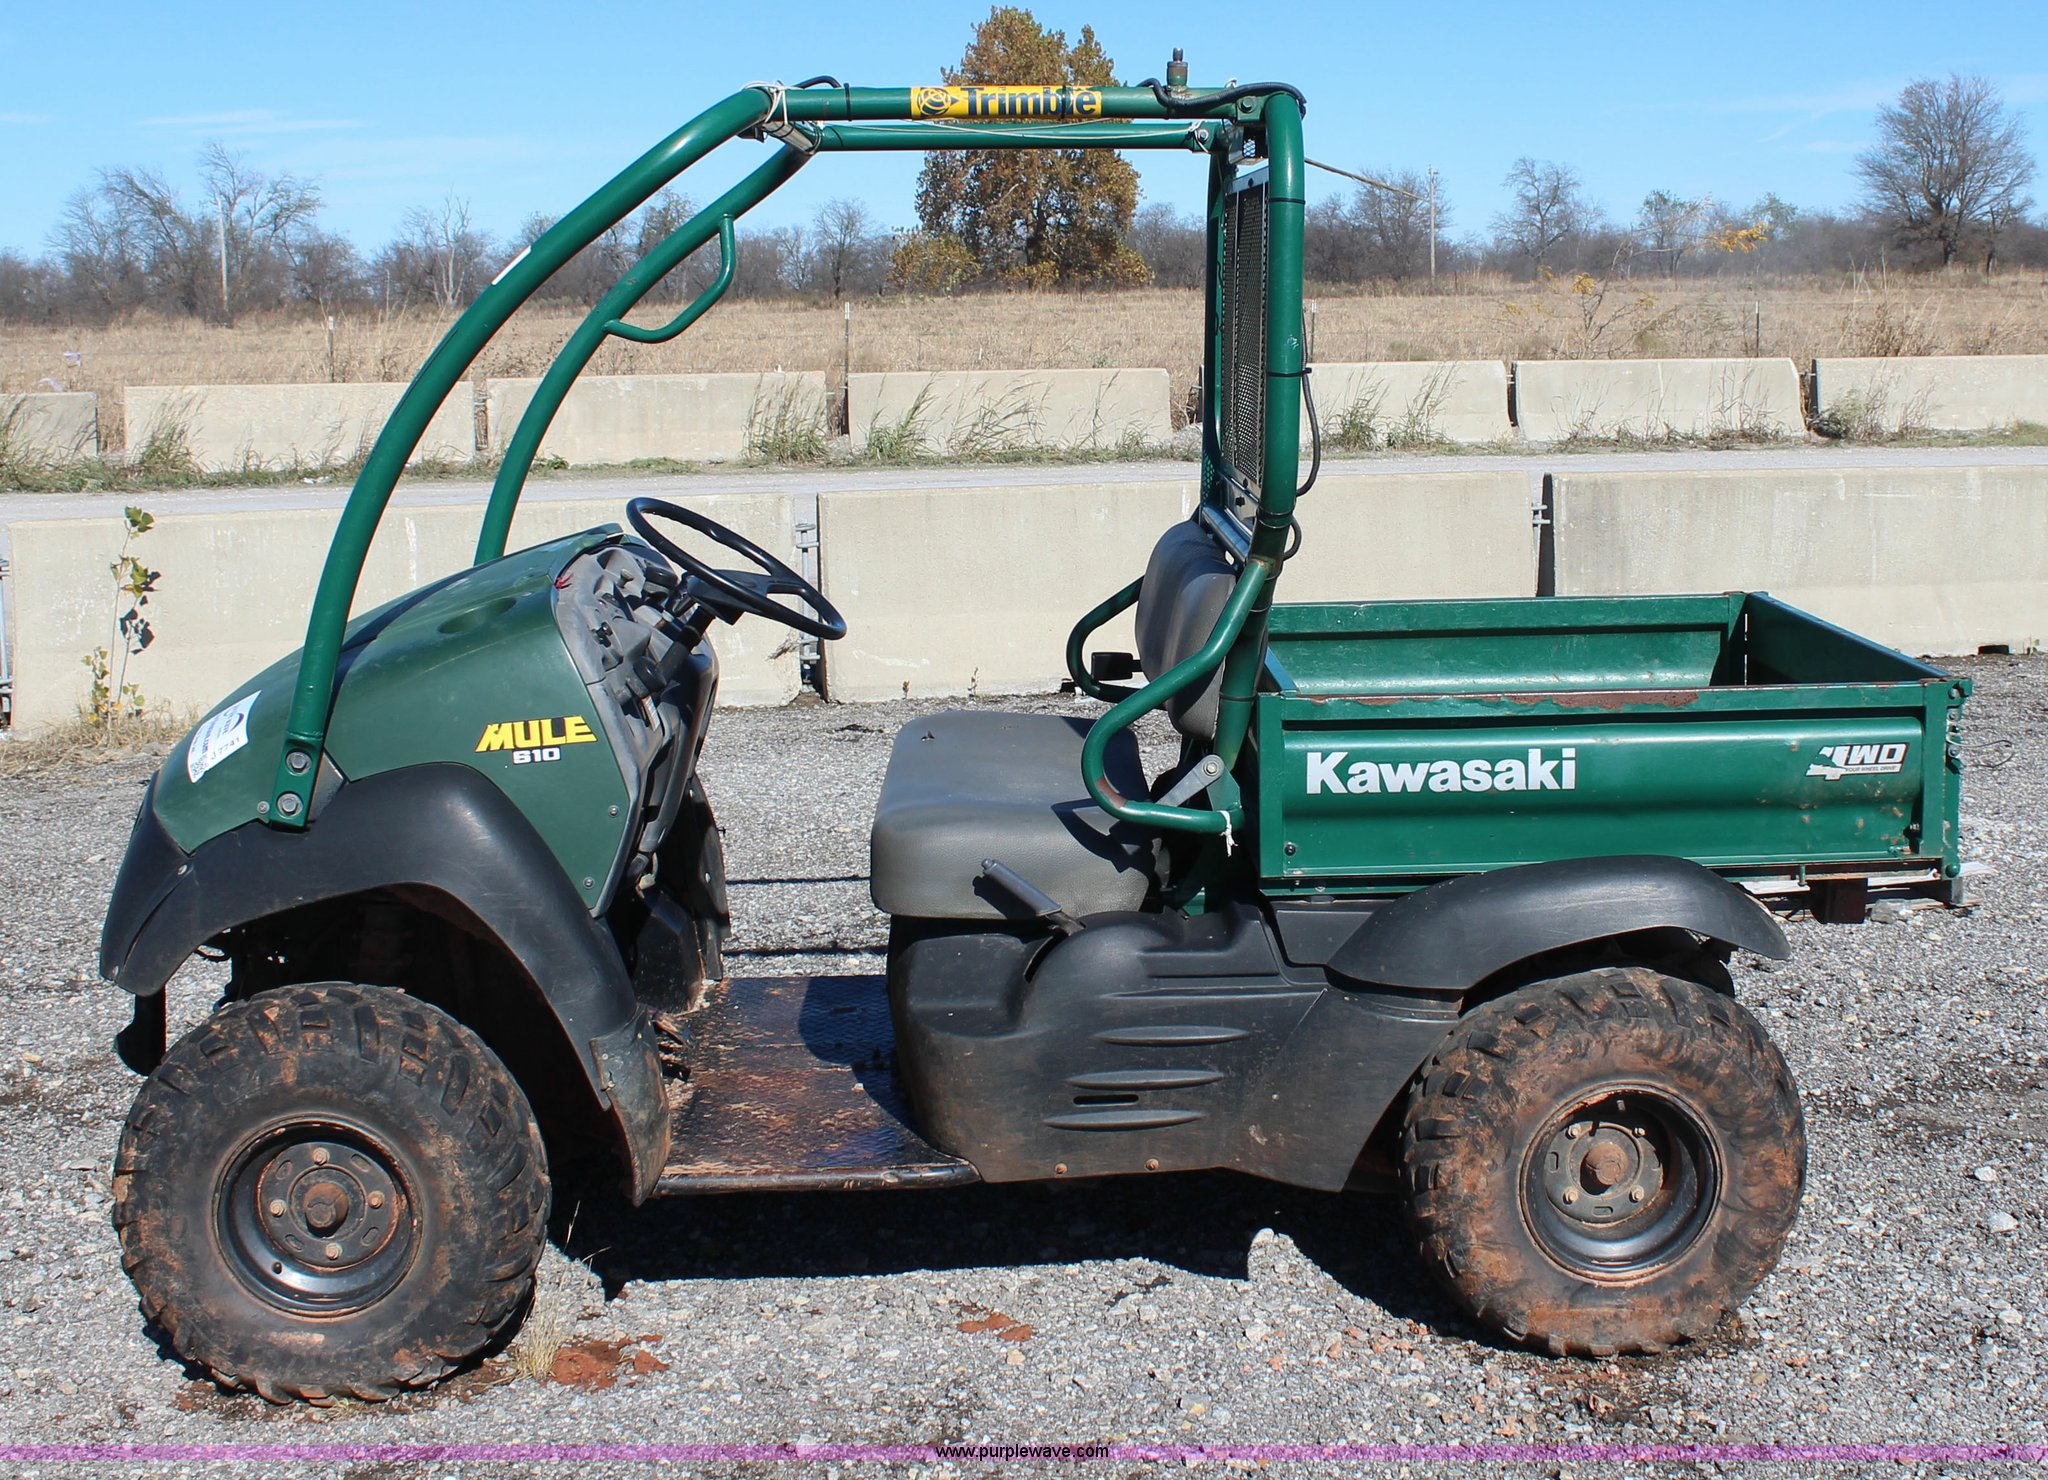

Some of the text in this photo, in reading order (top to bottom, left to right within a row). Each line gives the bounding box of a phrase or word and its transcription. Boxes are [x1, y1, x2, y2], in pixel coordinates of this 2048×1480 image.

[475, 716, 597, 752] MULE
[513, 747, 561, 764] 610
[1306, 748, 1576, 795] Kawasaki
